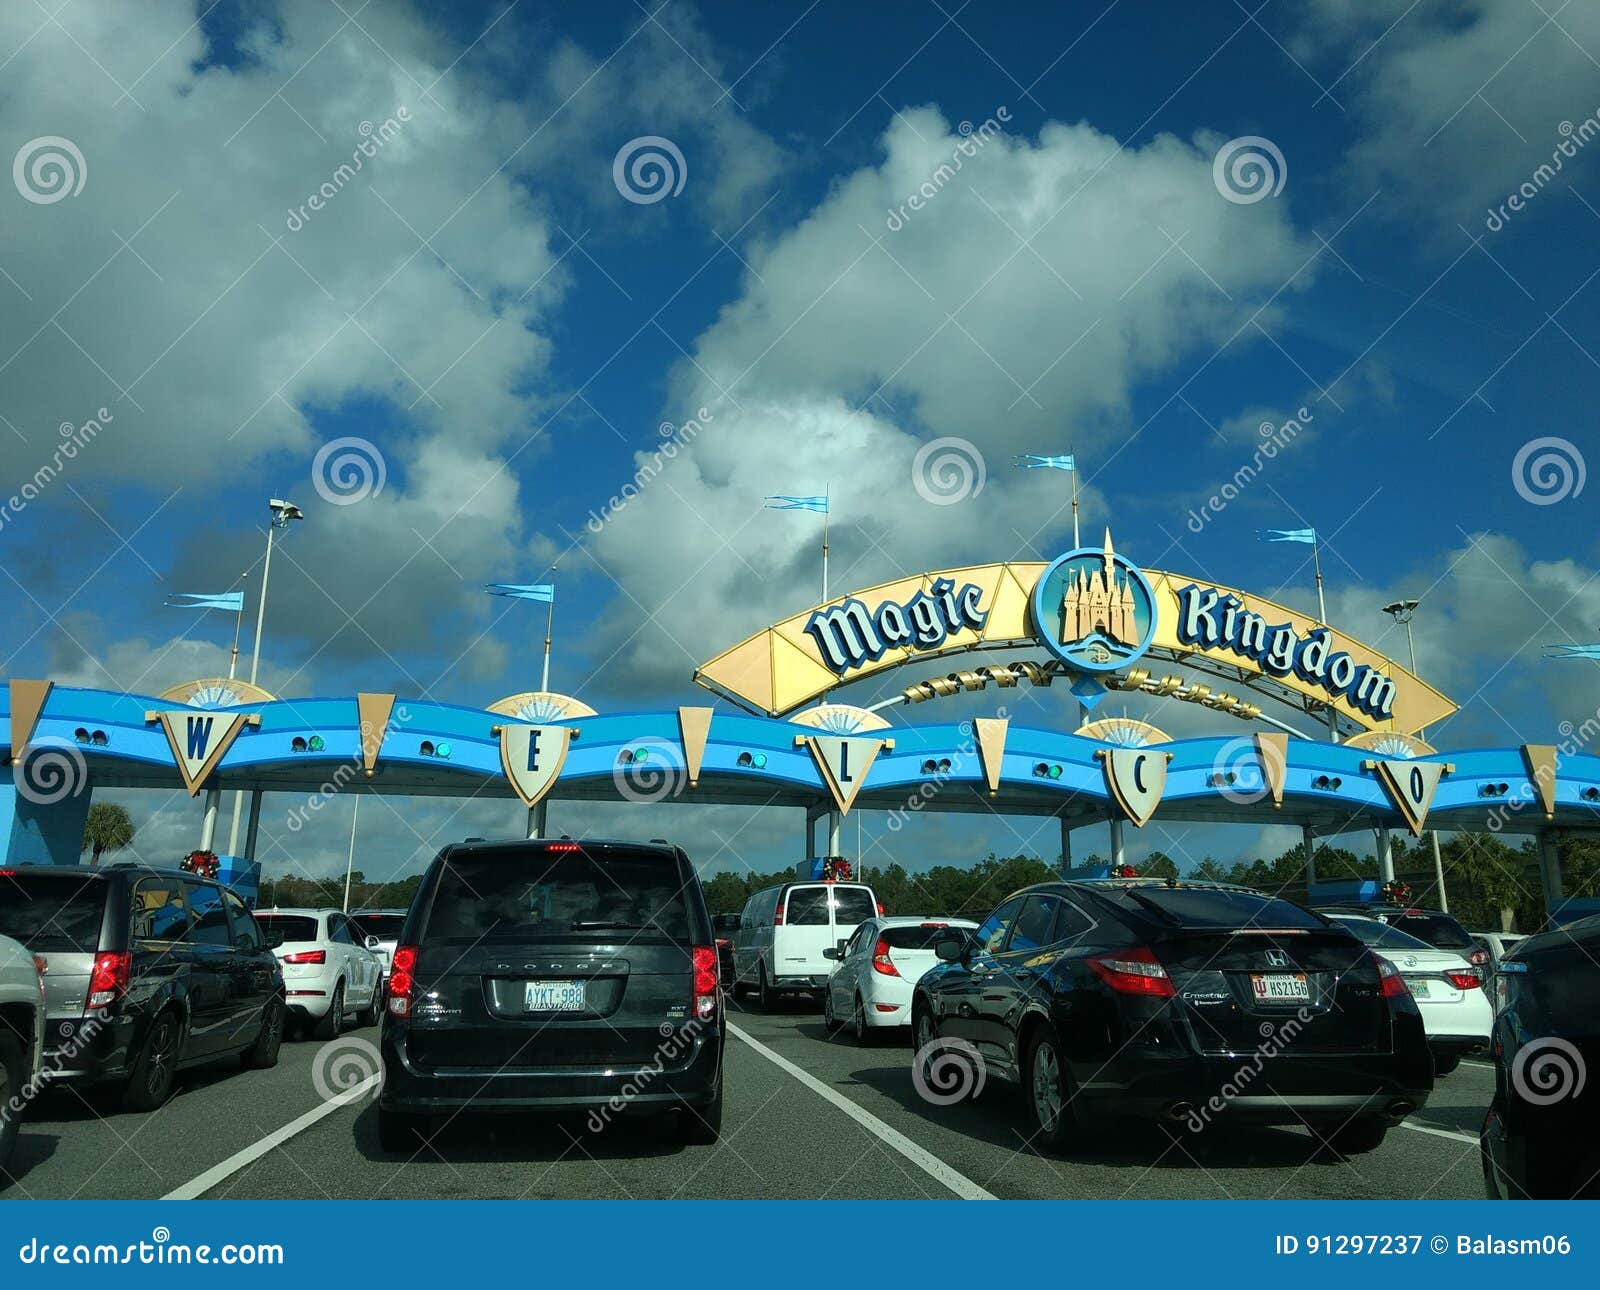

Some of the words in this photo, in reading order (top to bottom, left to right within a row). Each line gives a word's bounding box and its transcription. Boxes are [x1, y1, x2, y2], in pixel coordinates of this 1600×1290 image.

[803, 577, 989, 674] Magic
[1177, 583, 1398, 722] Kingdom
[187, 716, 214, 760] W
[527, 729, 542, 771] E
[840, 741, 853, 782] L
[1133, 754, 1147, 794] C
[1269, 981, 1308, 996] HS2156
